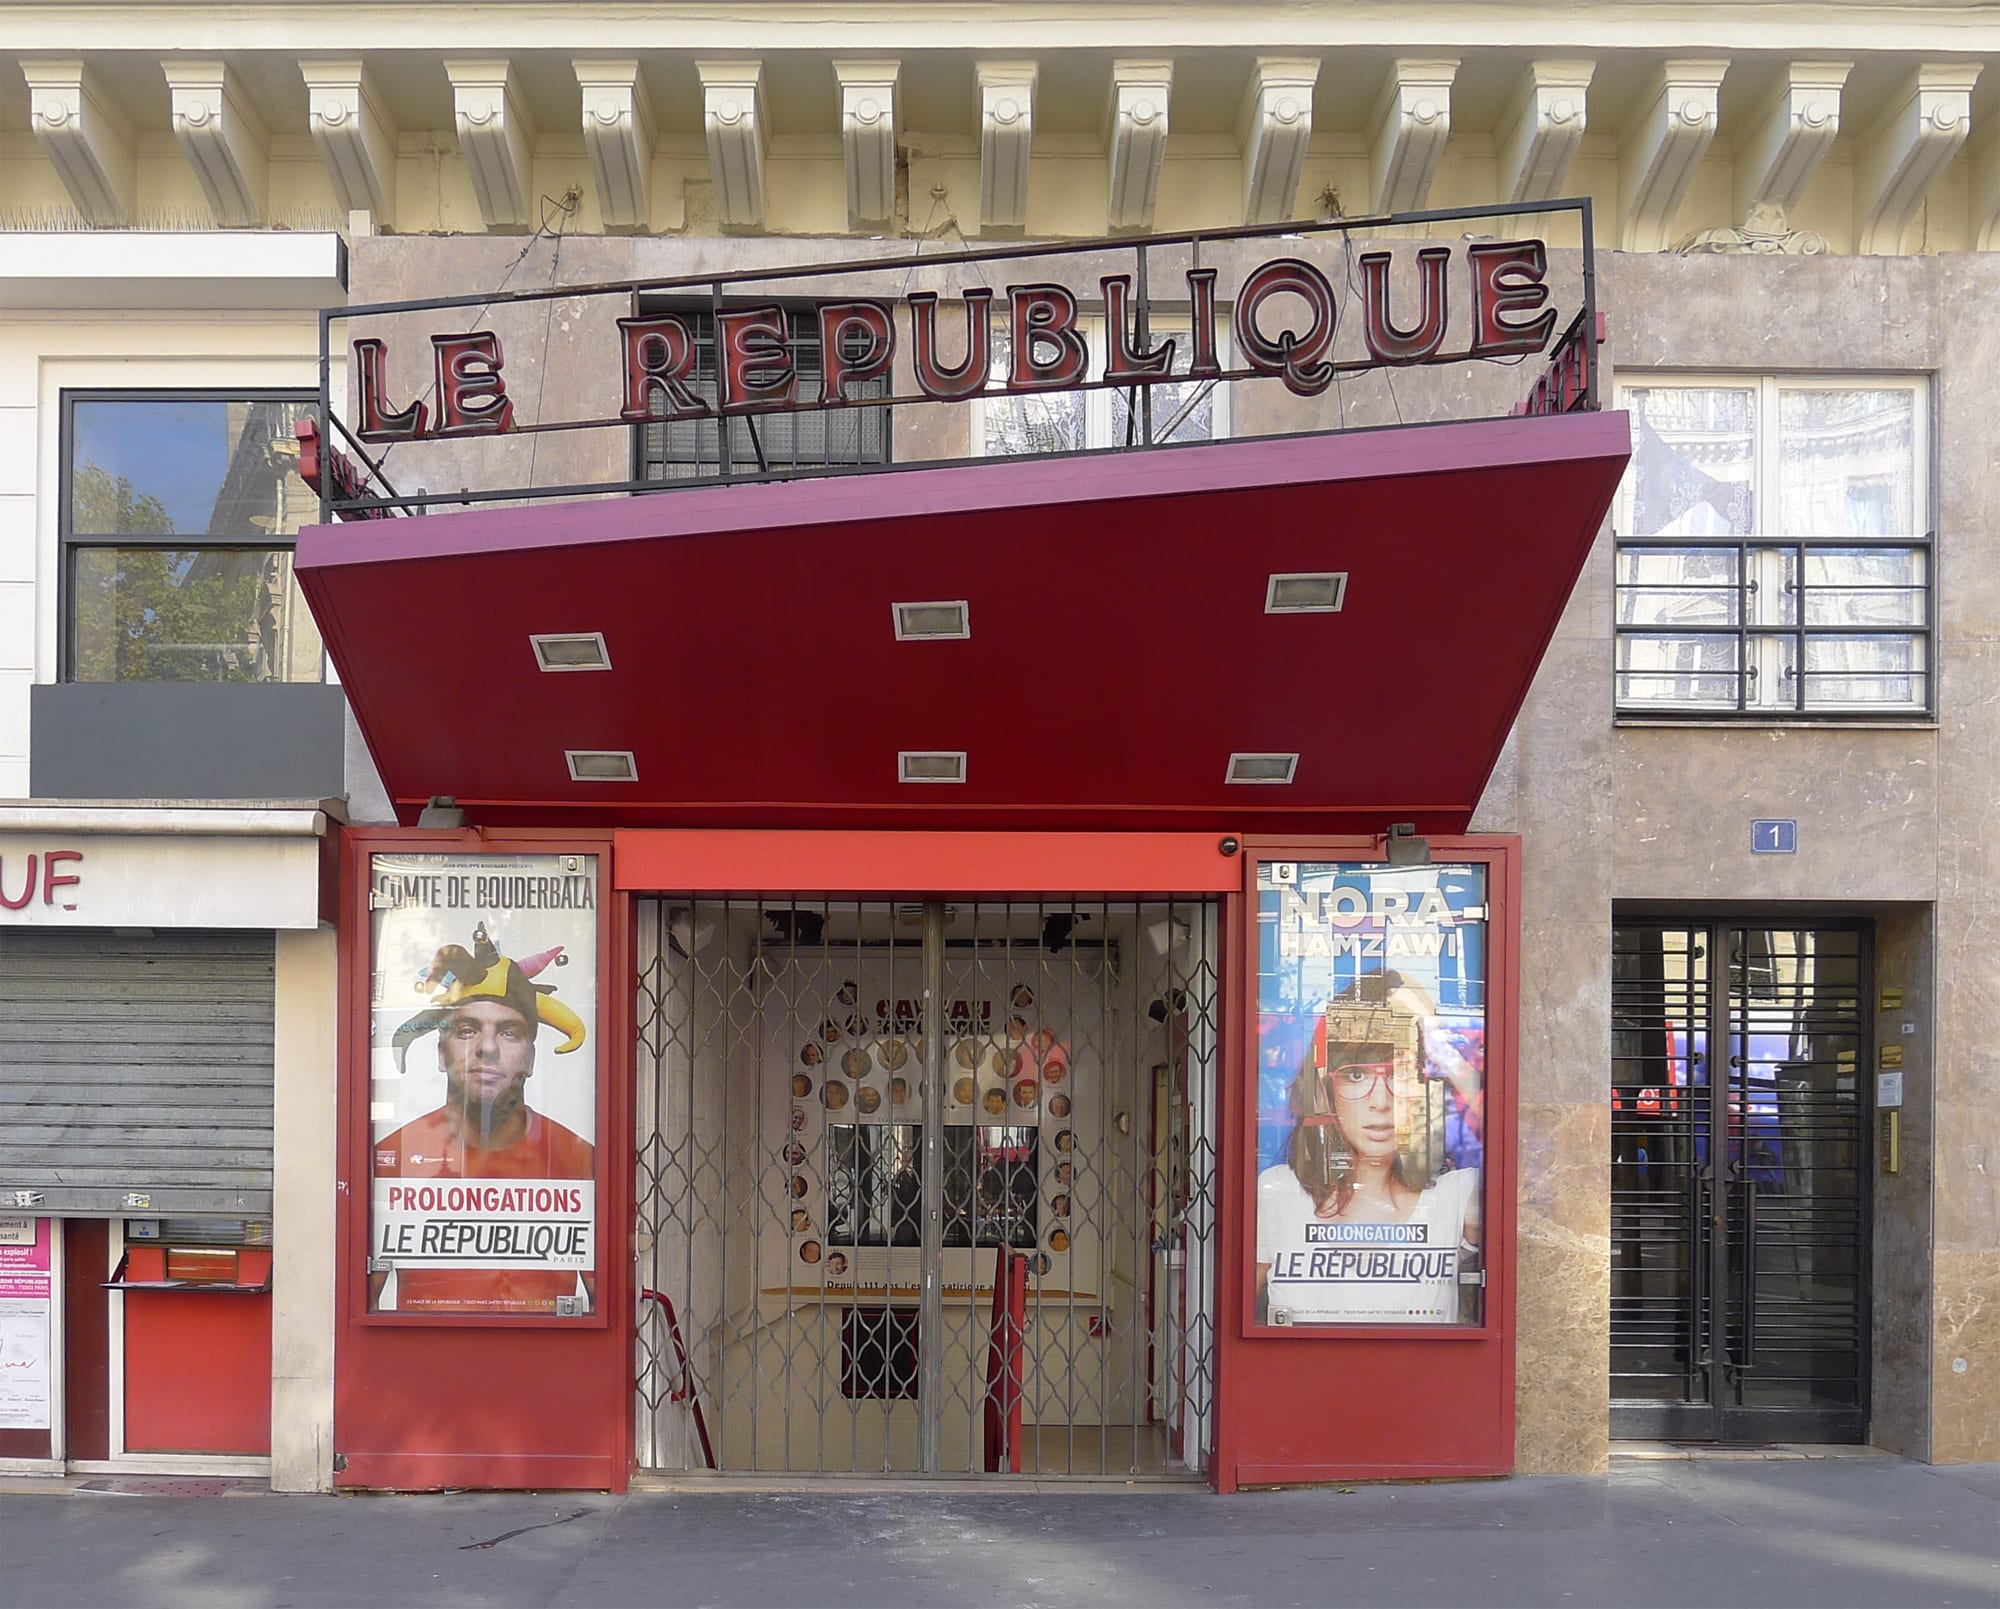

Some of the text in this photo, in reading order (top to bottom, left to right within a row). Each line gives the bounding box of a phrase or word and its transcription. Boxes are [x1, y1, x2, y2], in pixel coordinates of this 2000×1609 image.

[353, 239, 1559, 444] LE REPUBLIQUE
[1769, 825, 1778, 848] 1
[380, 875, 595, 910] COMTE DE BOUDERBALA
[1280, 886, 1456, 928] NORA
[1280, 933, 1457, 958] HAMZAWI
[876, 999, 991, 1020] CAVAU
[389, 1186, 582, 1213] PROLONGATIONS
[382, 1220, 590, 1258] LE RÉPUBLIQUE
[1309, 1226, 1425, 1241] PROLONGATIONS
[1274, 1249, 1456, 1280] LE RÉPUBLIQUE
